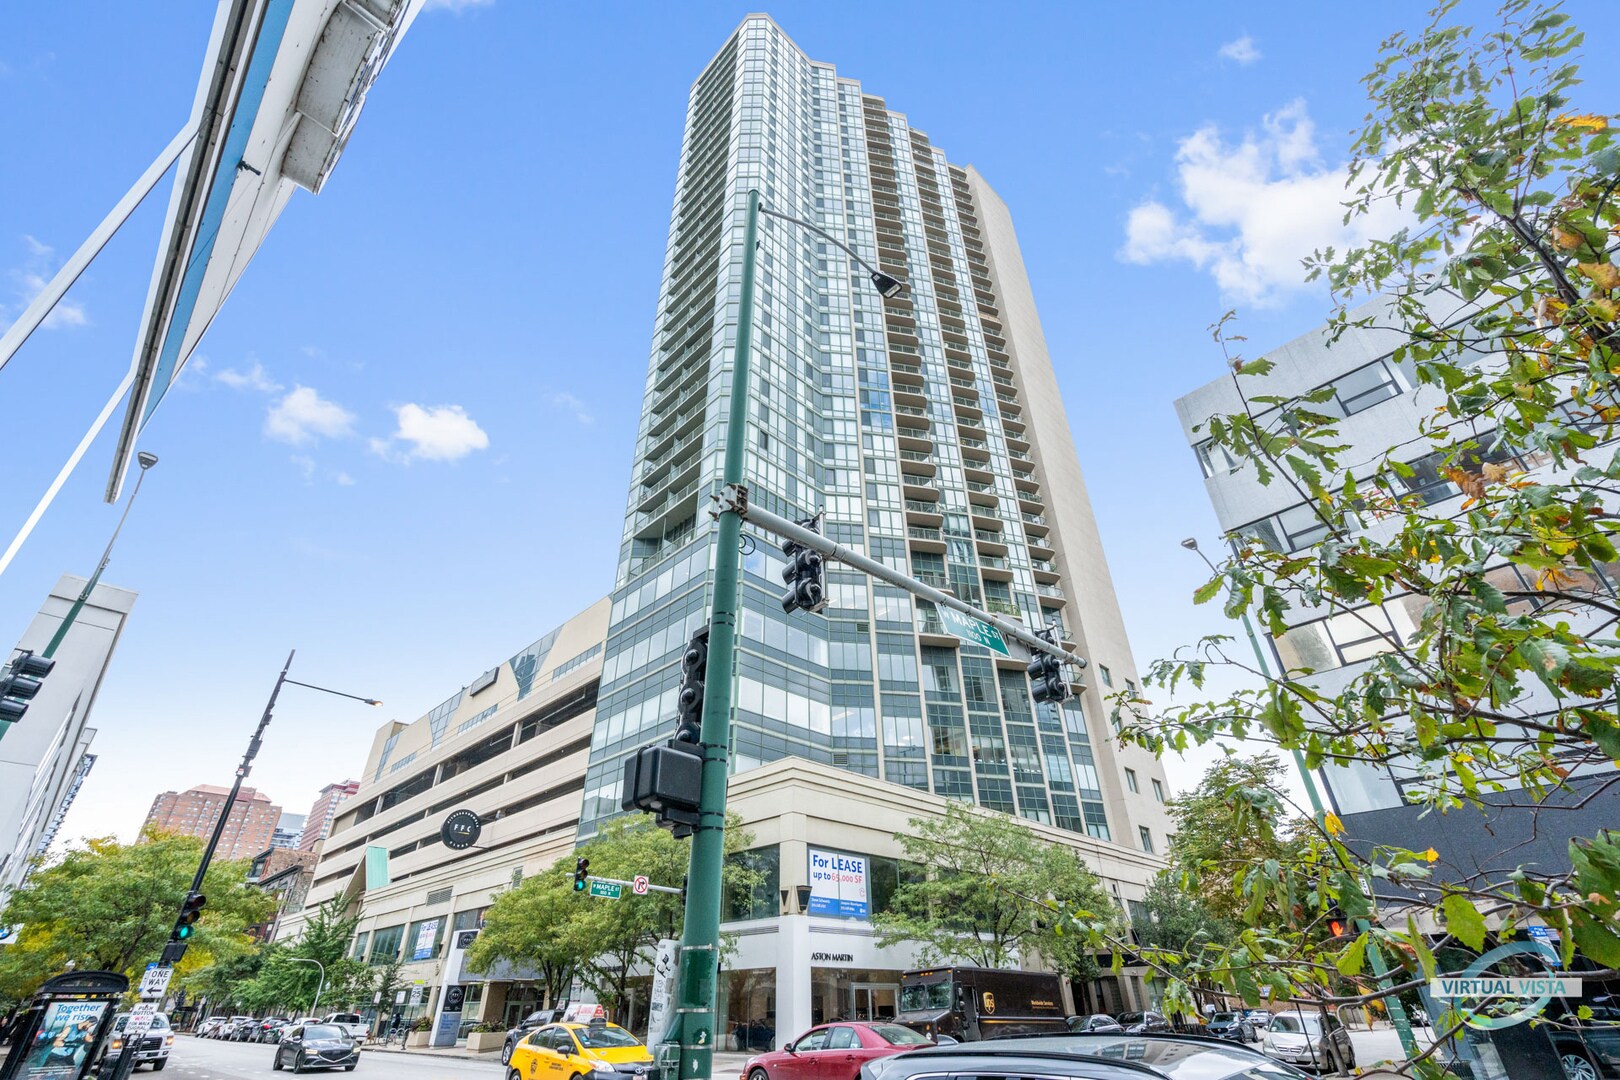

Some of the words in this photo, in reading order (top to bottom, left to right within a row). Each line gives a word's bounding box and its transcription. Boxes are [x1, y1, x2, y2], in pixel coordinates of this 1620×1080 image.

[951, 611, 992, 638] MAPLE
[812, 854, 829, 868] For
[831, 857, 863, 873] LEASE
[813, 872, 823, 880] up
[823, 872, 831, 880] to
[854, 875, 863, 883] SF
[596, 884, 615, 892] MAPLE
[811, 952, 831, 961] ASTON
[832, 953, 854, 962] MARTIN
[151, 970, 169, 978] ONE
[411, 990, 421, 998] 25
[57, 1004, 101, 1014] Together
